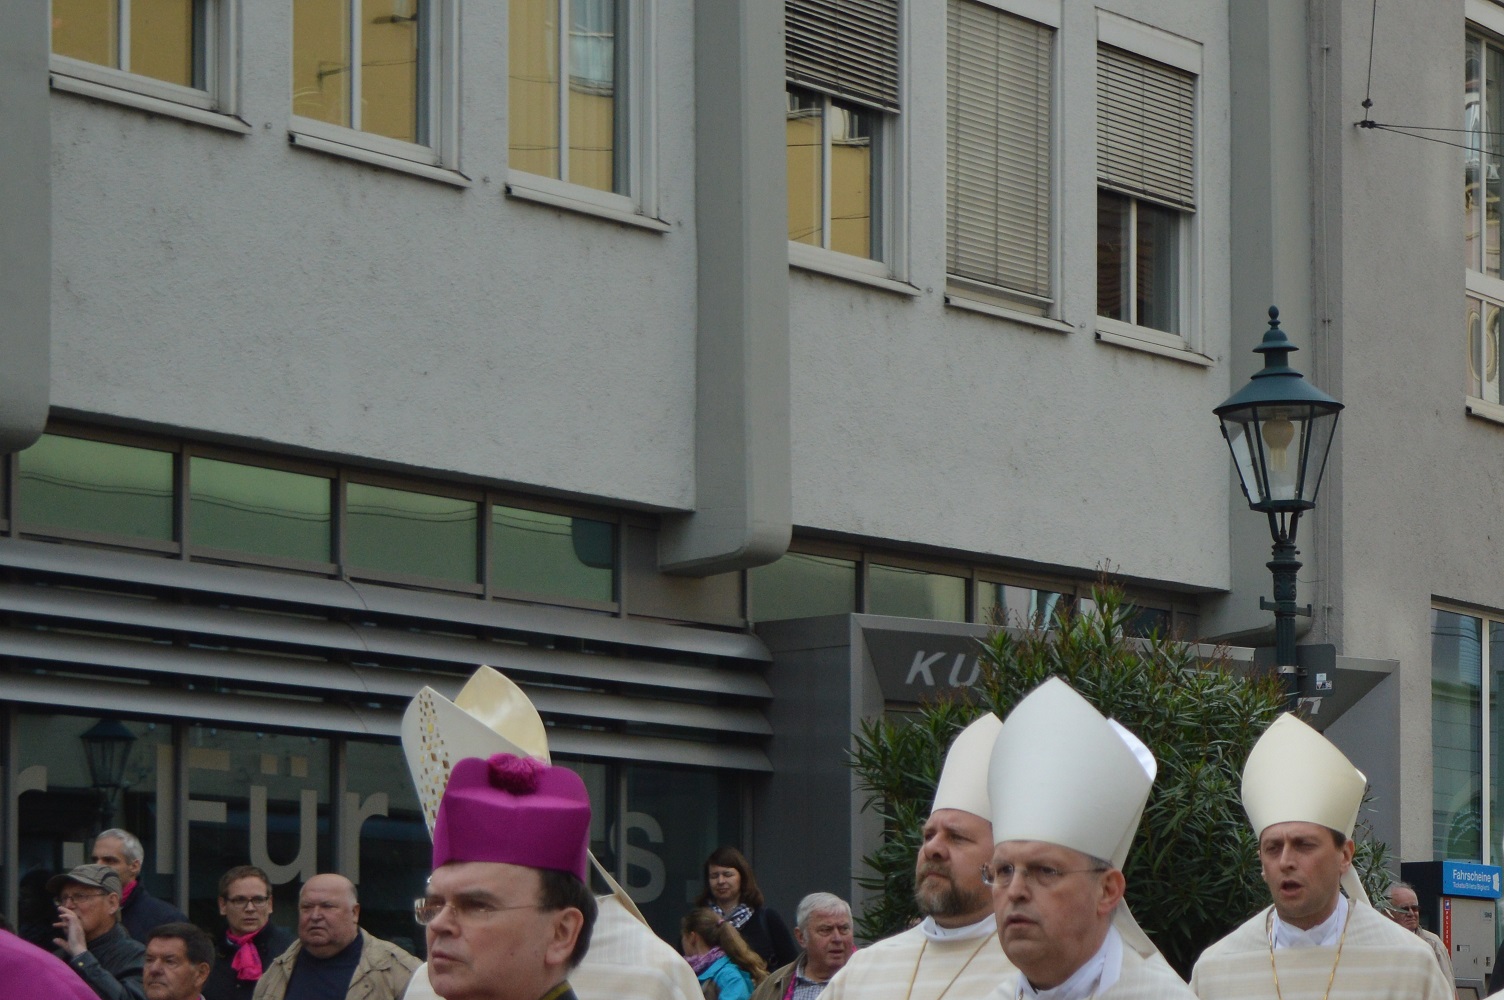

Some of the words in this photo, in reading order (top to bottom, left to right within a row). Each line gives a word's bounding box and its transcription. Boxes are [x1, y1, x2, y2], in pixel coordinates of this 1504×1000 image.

[905, 650, 982, 687] KU
[156, 743, 389, 886] Für
[1453, 869, 1491, 882] Fahrscheine
